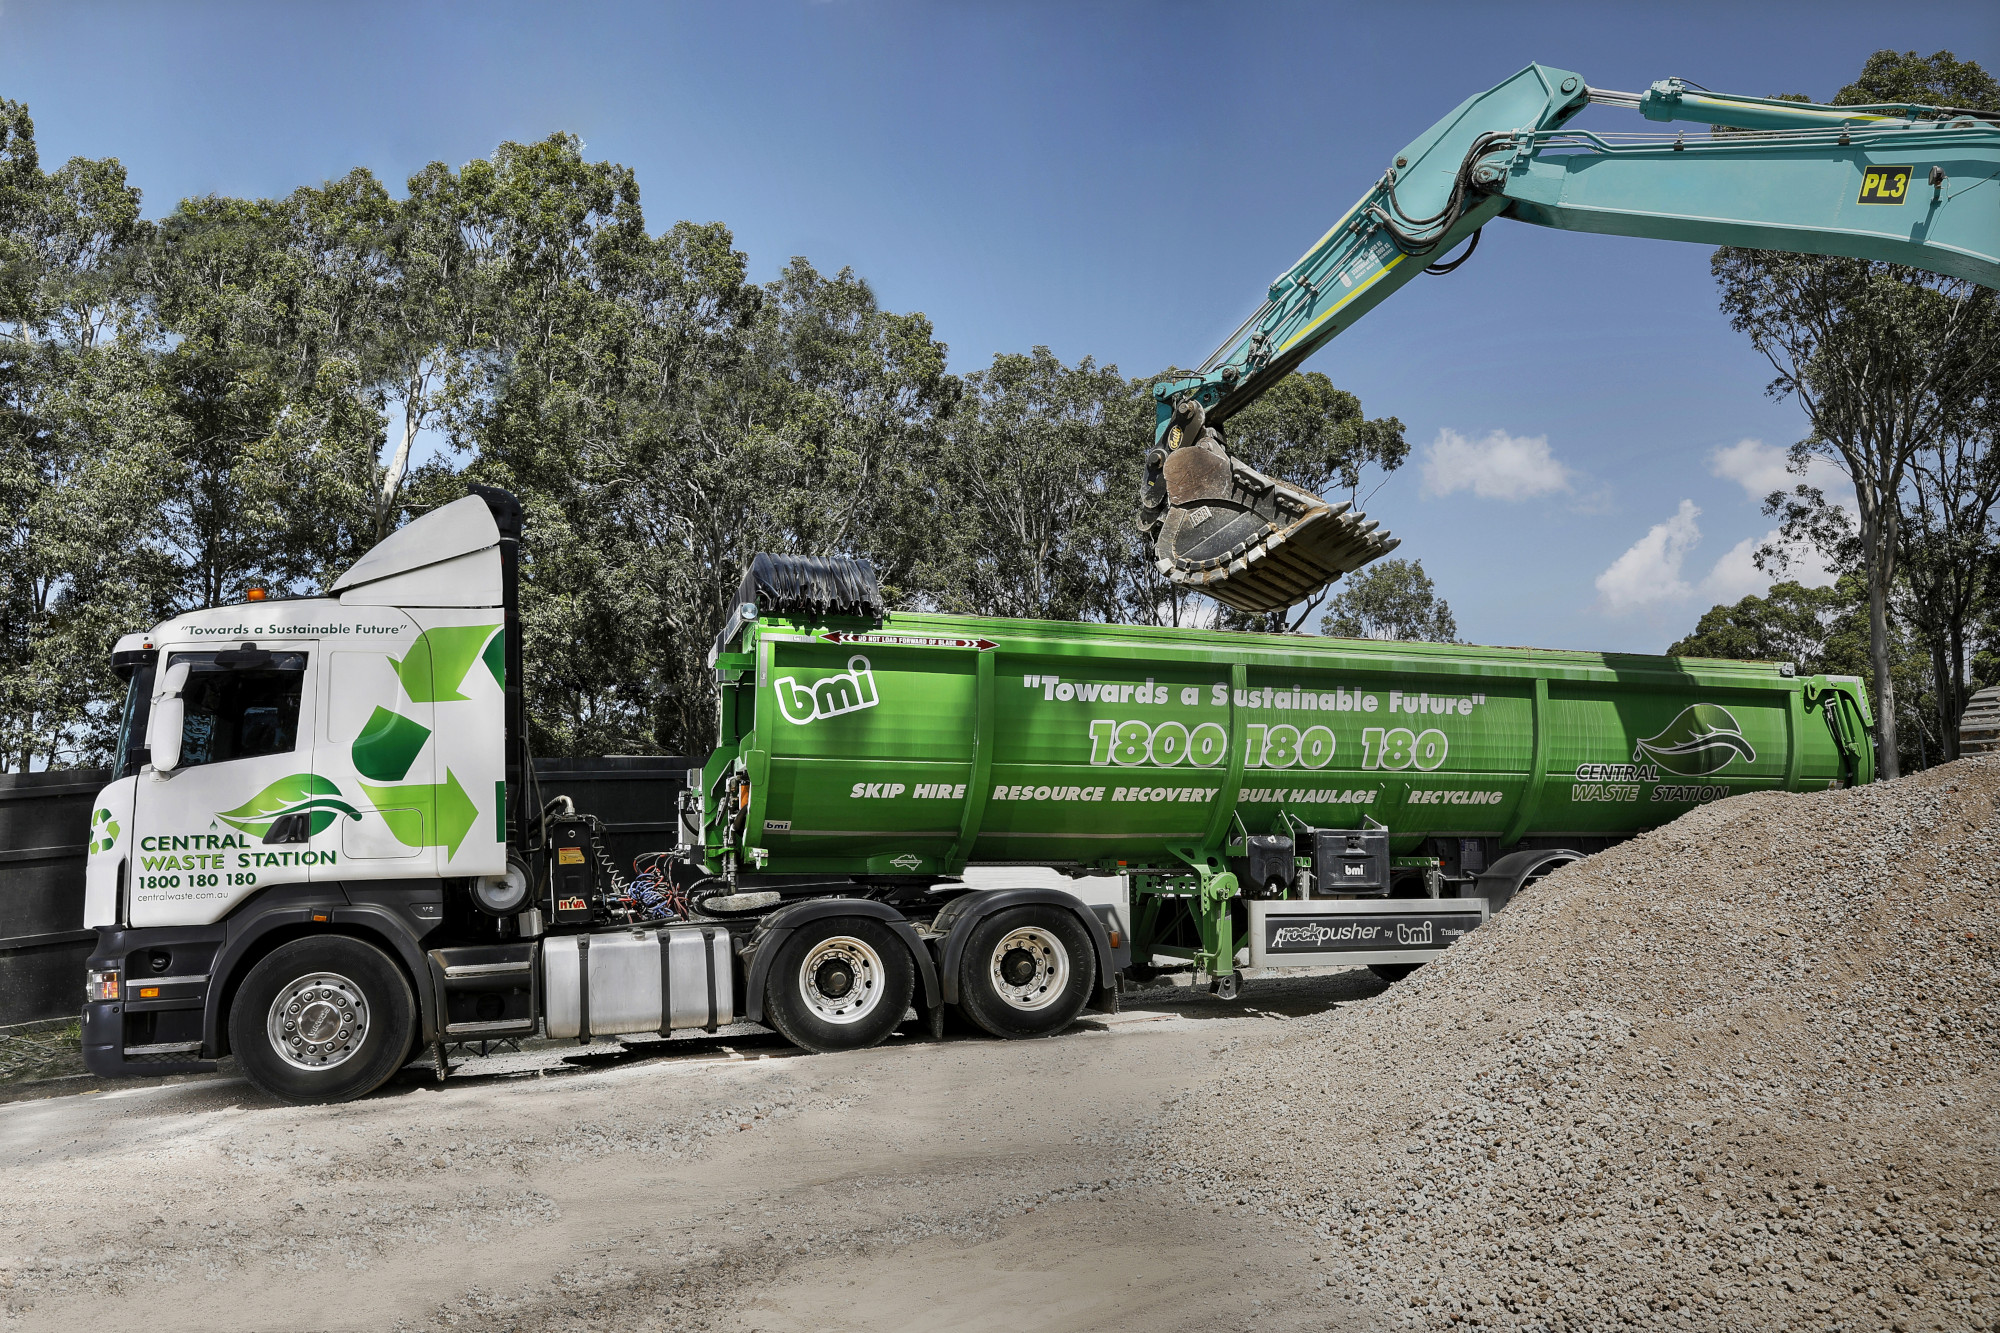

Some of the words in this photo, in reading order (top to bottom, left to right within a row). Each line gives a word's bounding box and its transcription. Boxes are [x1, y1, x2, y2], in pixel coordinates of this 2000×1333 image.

[1861, 173, 1907, 198] PL3
[254, 626, 263, 634] a
[268, 623, 351, 635] Sustainable
[898, 637, 927, 645] FORWARD
[928, 638, 937, 646] OF
[774, 654, 880, 725] bmi
[1023, 674, 1169, 704] "Towards
[1180, 686, 1199, 706] a
[1211, 682, 1378, 713] Sustainable
[1389, 689, 1486, 716] Future"
[1089, 719, 1228, 768] 1800
[1244, 723, 1336, 769] 180
[1361, 727, 1449, 771] 180
[1575, 763, 1660, 782] CENTRAL
[850, 782, 906, 799] SKIP
[912, 783, 967, 799] HIRE
[992, 785, 1107, 801] RESOURCE
[1111, 786, 1219, 803] RECOVERY
[1238, 788, 1289, 803] BULK
[1288, 789, 1378, 804] HAULAGE
[1407, 790, 1504, 805] RECYCLING
[1572, 784, 1640, 802] WASTE
[1650, 785, 1730, 802] STATION
[766, 821, 788, 831] bmi
[140, 834, 251, 852] CENTRAL
[140, 853, 225, 872] WASTE
[237, 850, 337, 868] STATION
[1344, 864, 1364, 876] bmi
[138, 875, 181, 889] 1800
[188, 874, 219, 888] 180
[226, 873, 257, 886] 180
[137, 891, 229, 902] centralwaste.com.au
[560, 898, 586, 910] HYVA
[1384, 929, 1393, 938] by
[1396, 921, 1433, 945] bmi
